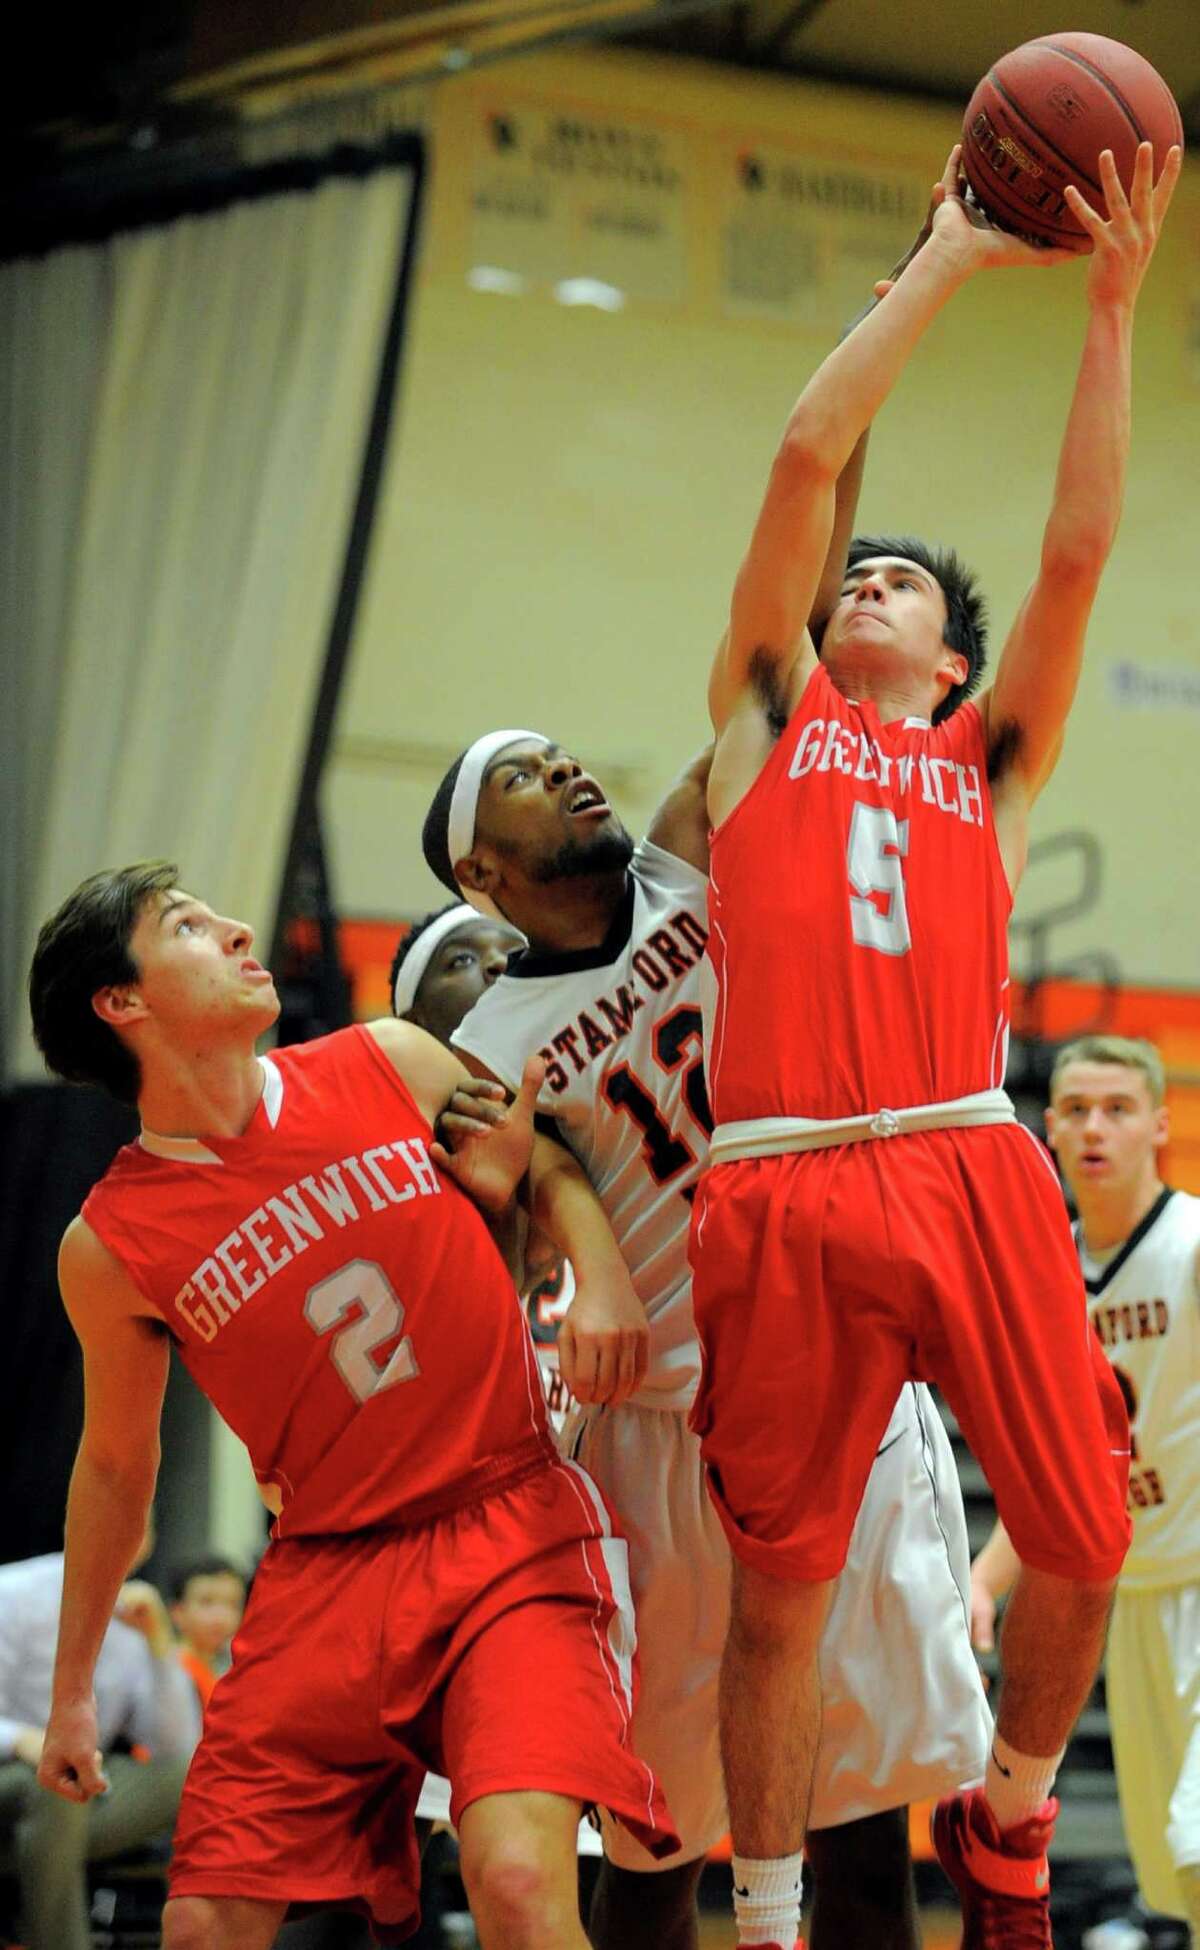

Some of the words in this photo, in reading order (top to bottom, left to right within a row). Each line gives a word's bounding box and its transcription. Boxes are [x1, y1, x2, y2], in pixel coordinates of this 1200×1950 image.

[788, 718, 983, 829] GREENWICH
[847, 800, 912, 957] 5
[537, 910, 709, 1094] STAMORD
[175, 1137, 440, 1343] GREENWICH
[303, 1257, 421, 1406] 2
